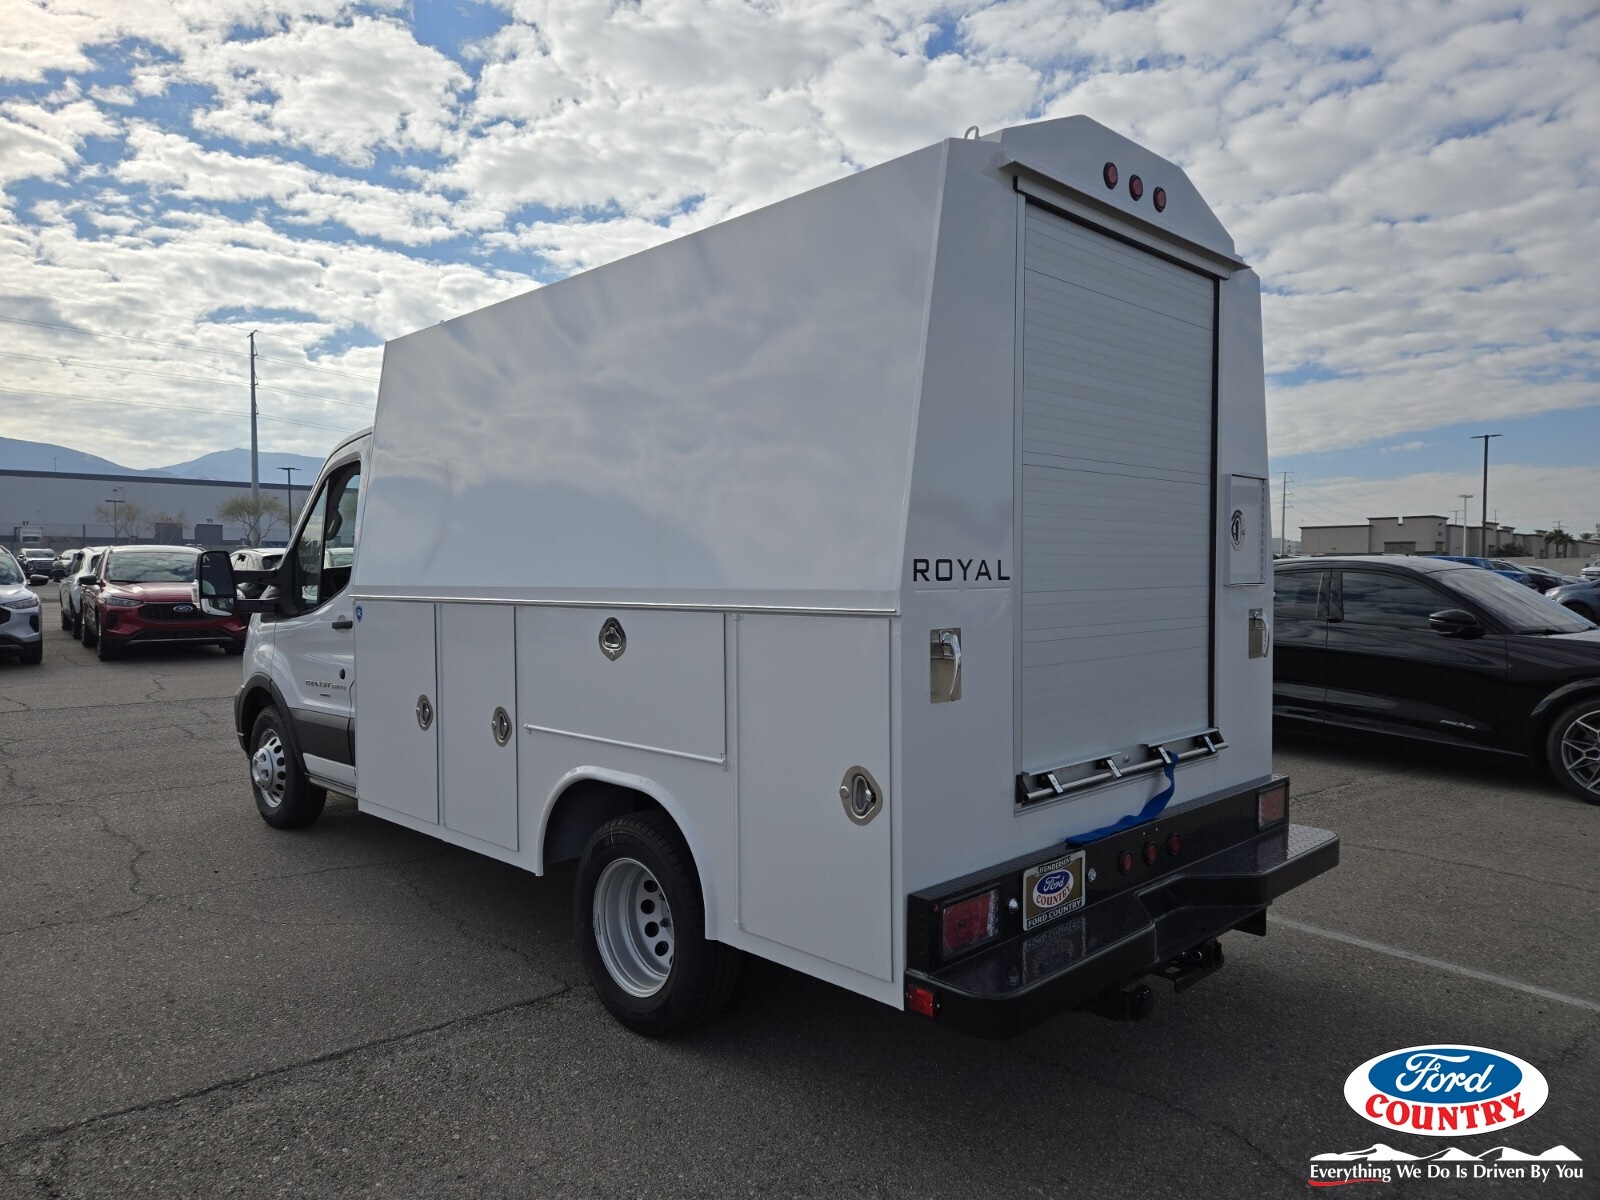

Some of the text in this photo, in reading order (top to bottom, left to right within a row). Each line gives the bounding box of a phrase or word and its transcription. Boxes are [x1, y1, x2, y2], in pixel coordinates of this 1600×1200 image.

[913, 558, 1010, 581] ROYAL
[1039, 858, 1070, 874] HENDERSON
[1043, 875, 1065, 892] Ford
[1036, 886, 1071, 905] COUNTRY
[1028, 900, 1081, 928] FORD COUNTRY
